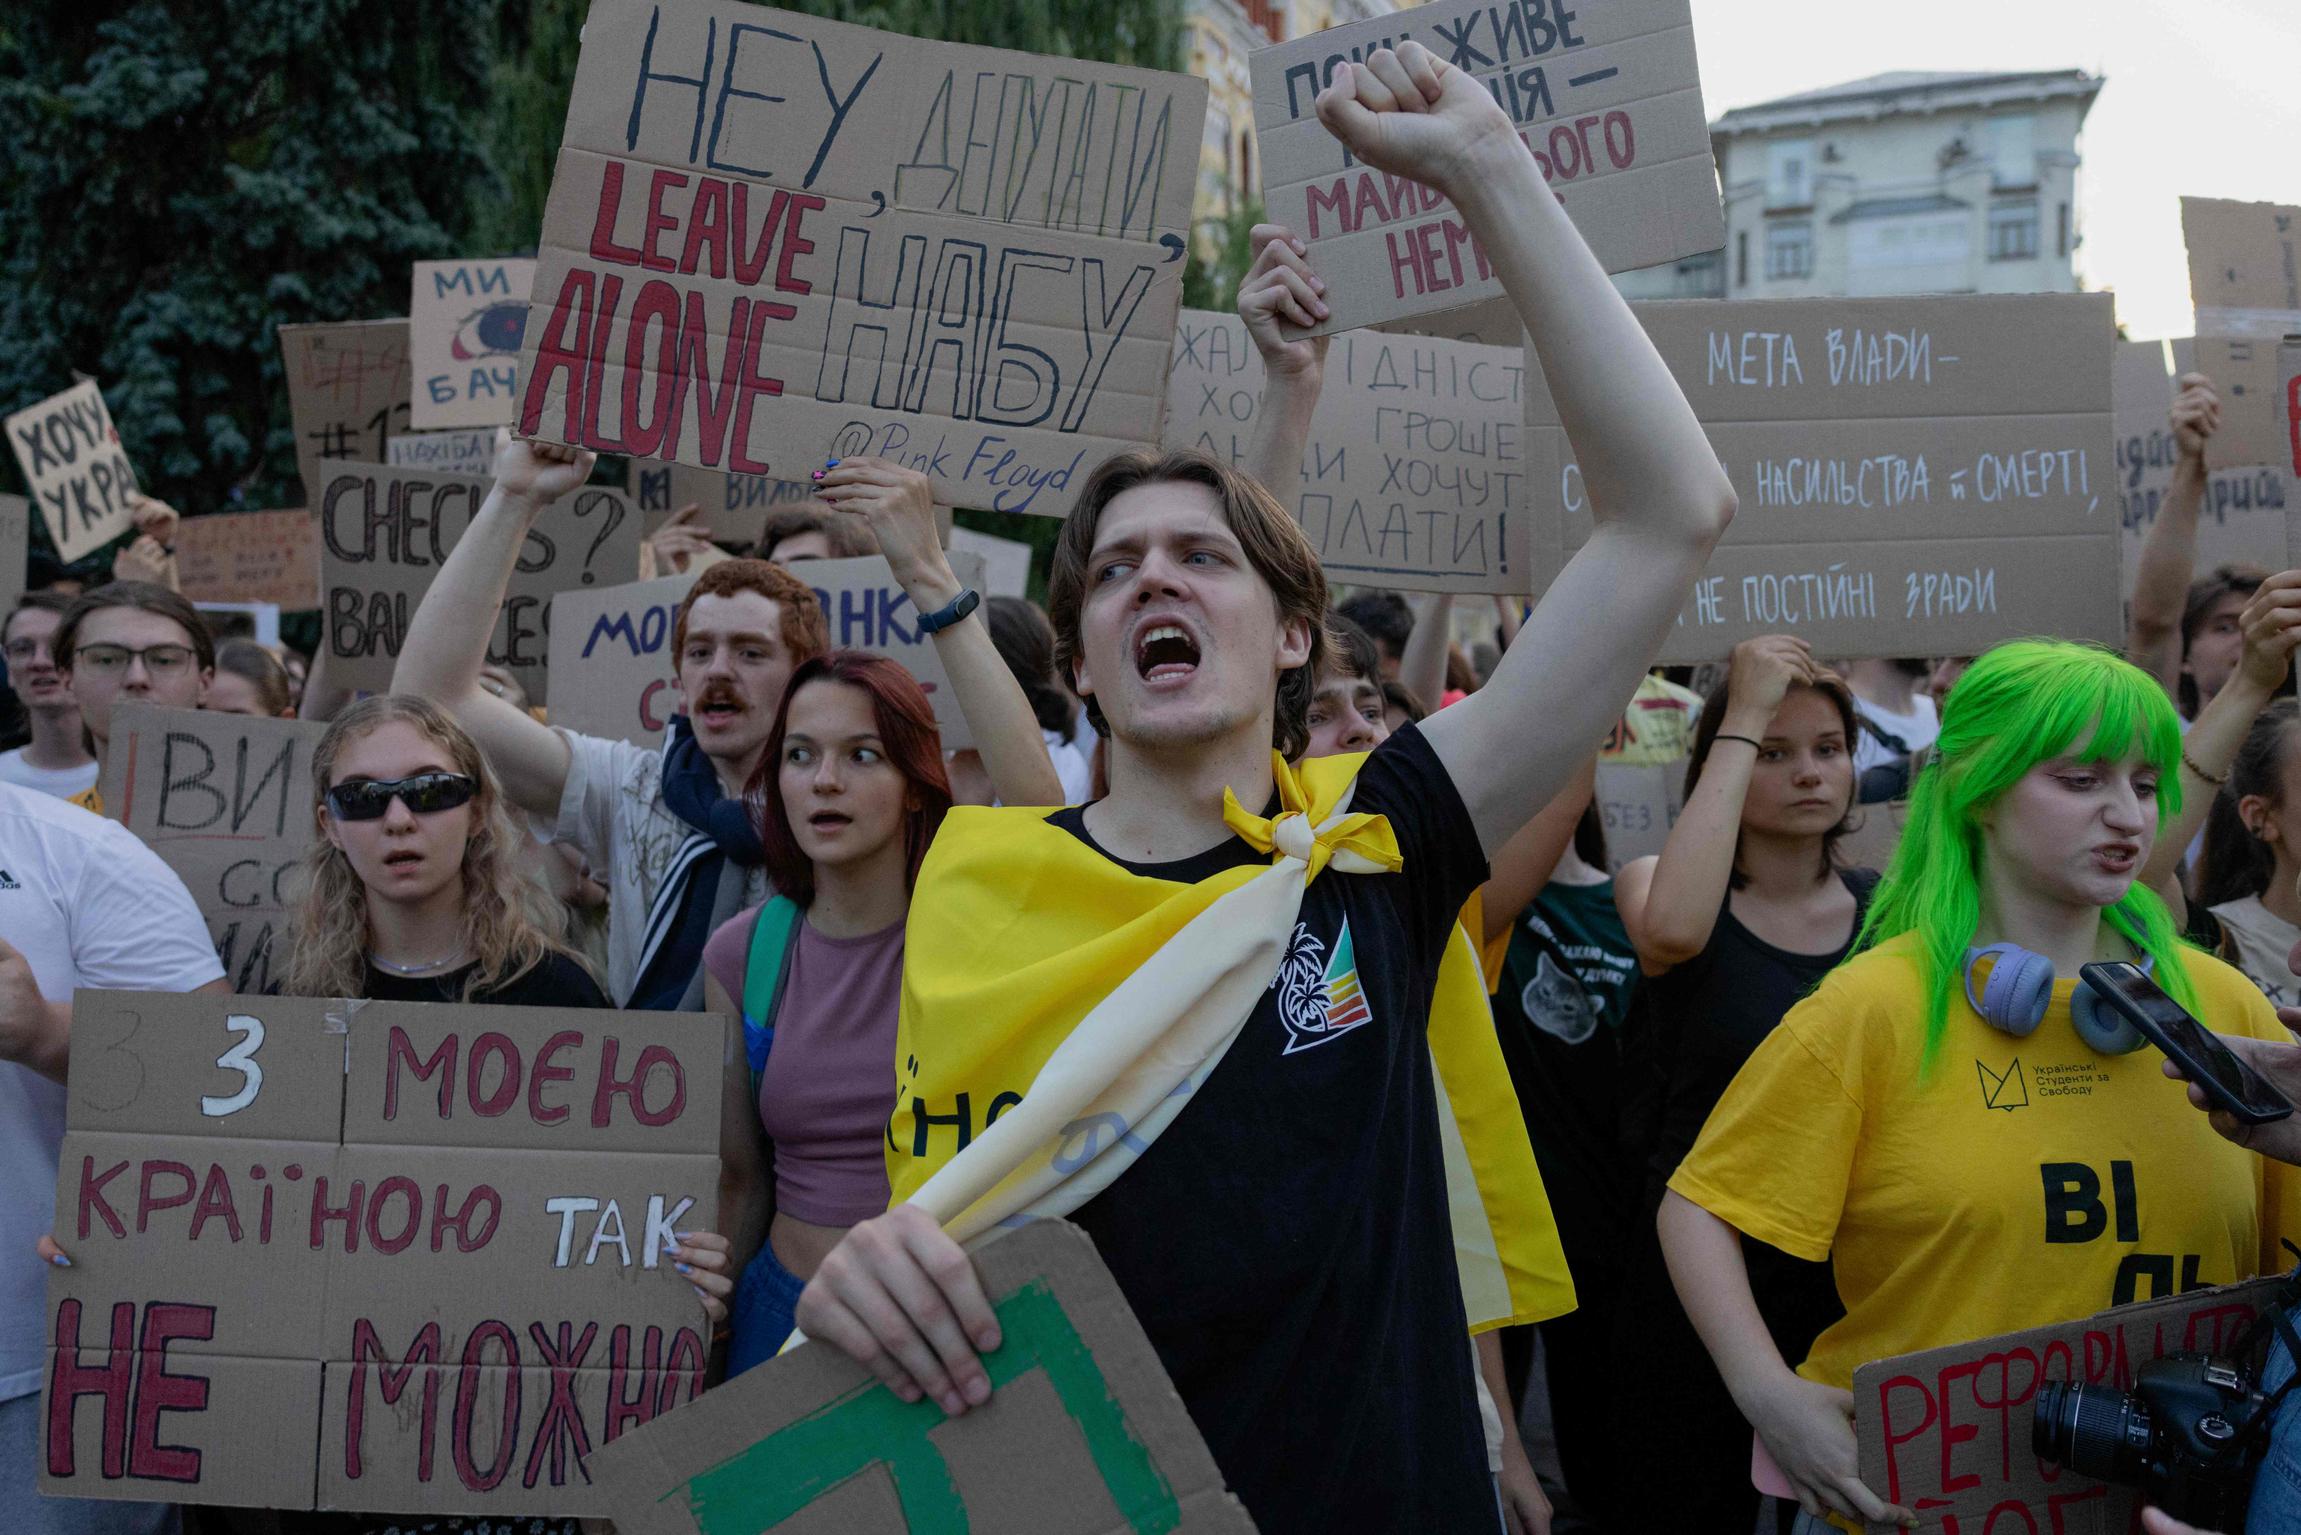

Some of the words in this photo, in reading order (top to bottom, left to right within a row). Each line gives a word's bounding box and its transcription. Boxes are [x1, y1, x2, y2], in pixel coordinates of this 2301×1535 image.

[589, 161, 826, 295] LEAVE
[433, 267, 510, 299] МИ
[816, 226, 1157, 433] НАБУ
[1707, 331, 1803, 387] МЕТА
[519, 267, 797, 476] ALONE
[18, 394, 104, 476] ХОЧУ
[963, 436, 1087, 513] Floyd
[1757, 454, 1929, 508] НАСИЛЬСТВА
[1695, 576, 1726, 626] НЕ
[1742, 562, 1876, 624] ПОСТІЙНІ
[1905, 567, 1996, 619] ЗРАДИ
[383, 1026, 688, 1129] МОЄЮ
[2033, 1061, 2097, 1076] Українські
[2036, 1075, 2093, 1087] Студенти
[2097, 1074, 2110, 1082] за
[2039, 1086, 2092, 1097] Свободу
[77, 1155, 502, 1255] КРАЇНОЮ
[545, 1193, 697, 1269] ТАК
[46, 1298, 217, 1484] НЕ
